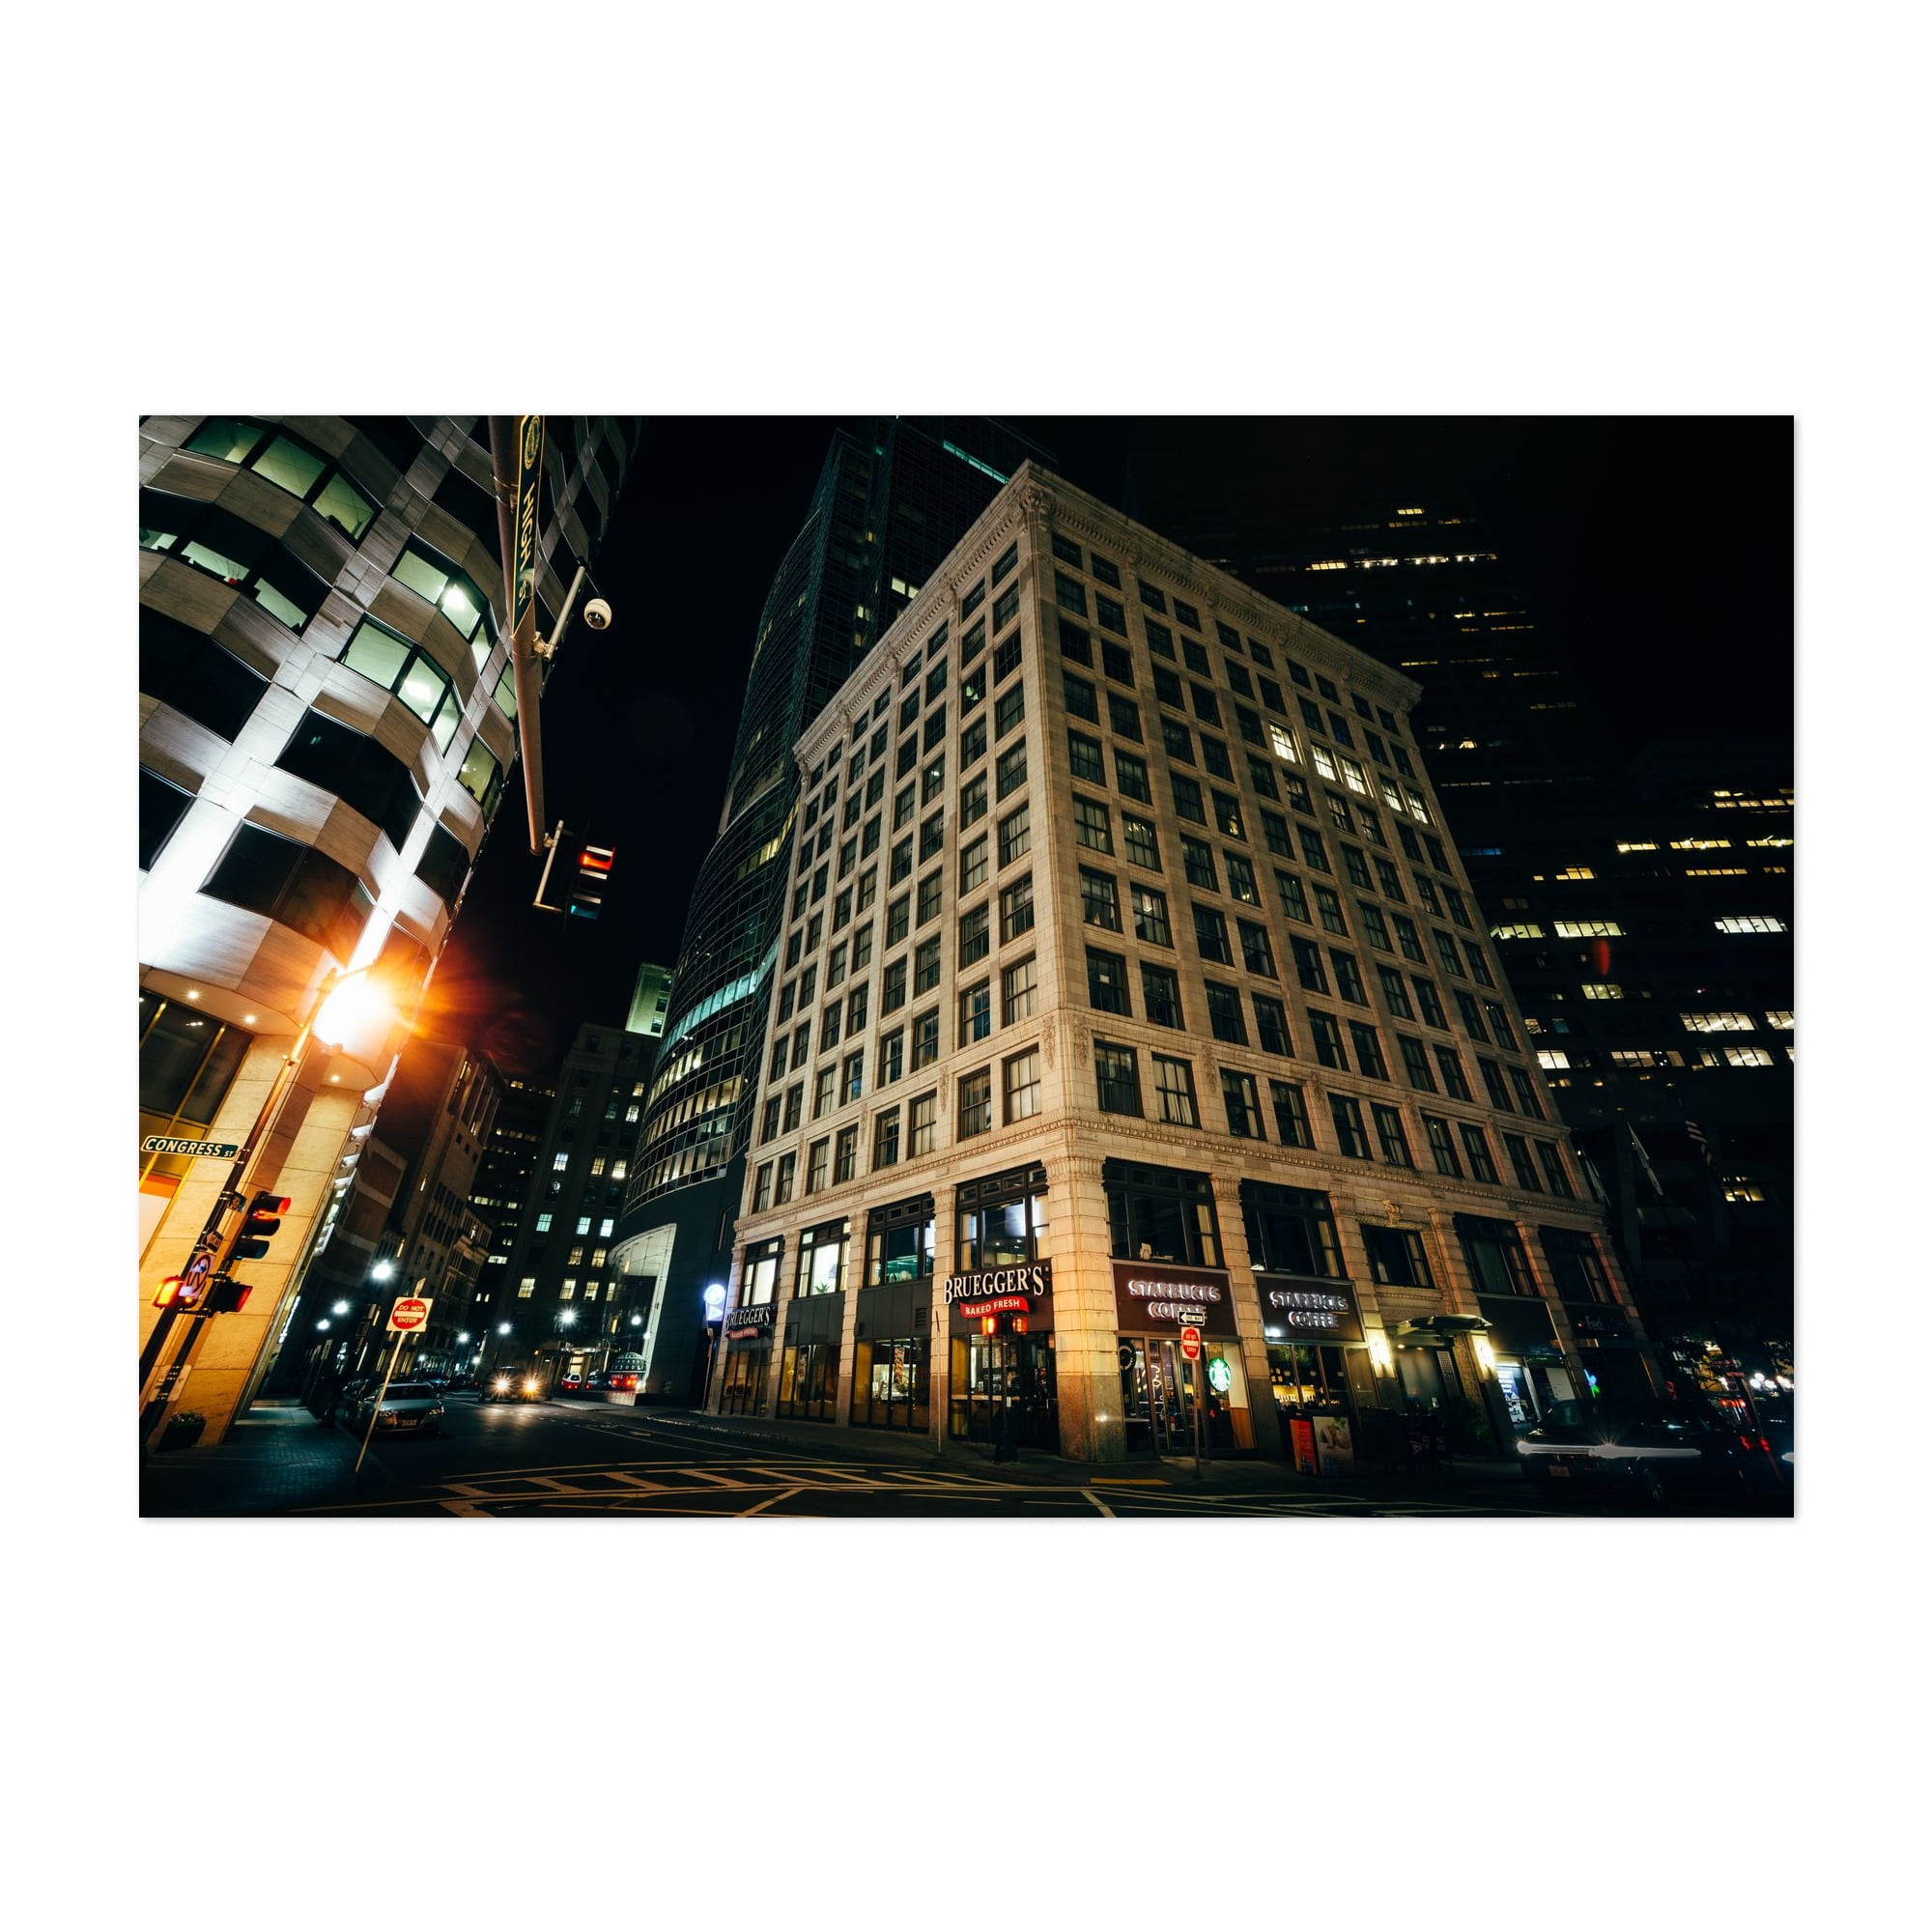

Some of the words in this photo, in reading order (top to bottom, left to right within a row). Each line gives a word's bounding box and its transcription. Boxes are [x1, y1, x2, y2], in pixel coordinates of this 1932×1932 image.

[520, 482, 535, 572] HIGH
[145, 1138, 223, 1156] CONGRESS
[943, 1265, 1044, 1305] BRUEGGER'S
[1127, 1280, 1222, 1302] STARBUCKS
[965, 1304, 991, 1316] BAKED
[993, 1298, 1020, 1312] FRESH
[1268, 1291, 1350, 1311] STARBUCKS
[724, 1306, 771, 1331] BRUEGGER'S
[1288, 1311, 1339, 1328] COFFEE
